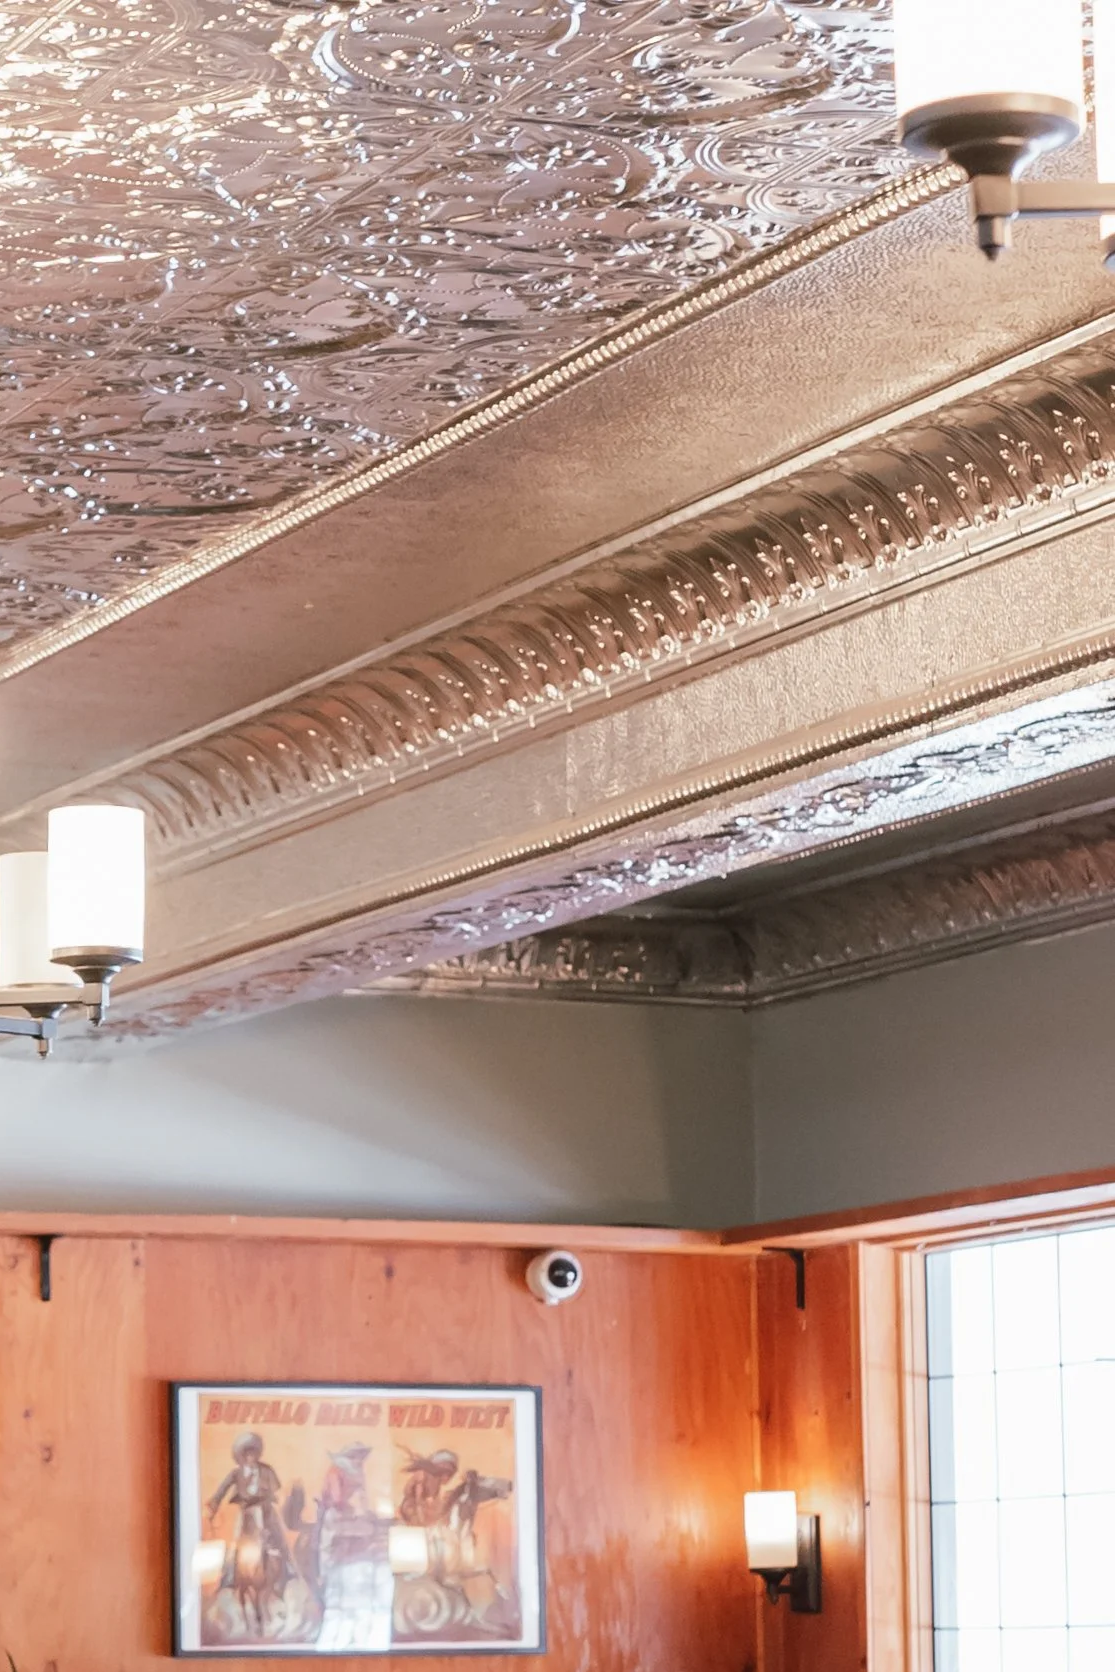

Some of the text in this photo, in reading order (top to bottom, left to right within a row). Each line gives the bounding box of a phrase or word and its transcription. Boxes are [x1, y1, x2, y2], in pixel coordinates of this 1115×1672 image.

[205, 1400, 312, 1425] BUFFALO
[388, 1404, 445, 1428] WILD
[449, 1405, 510, 1429] WEST
